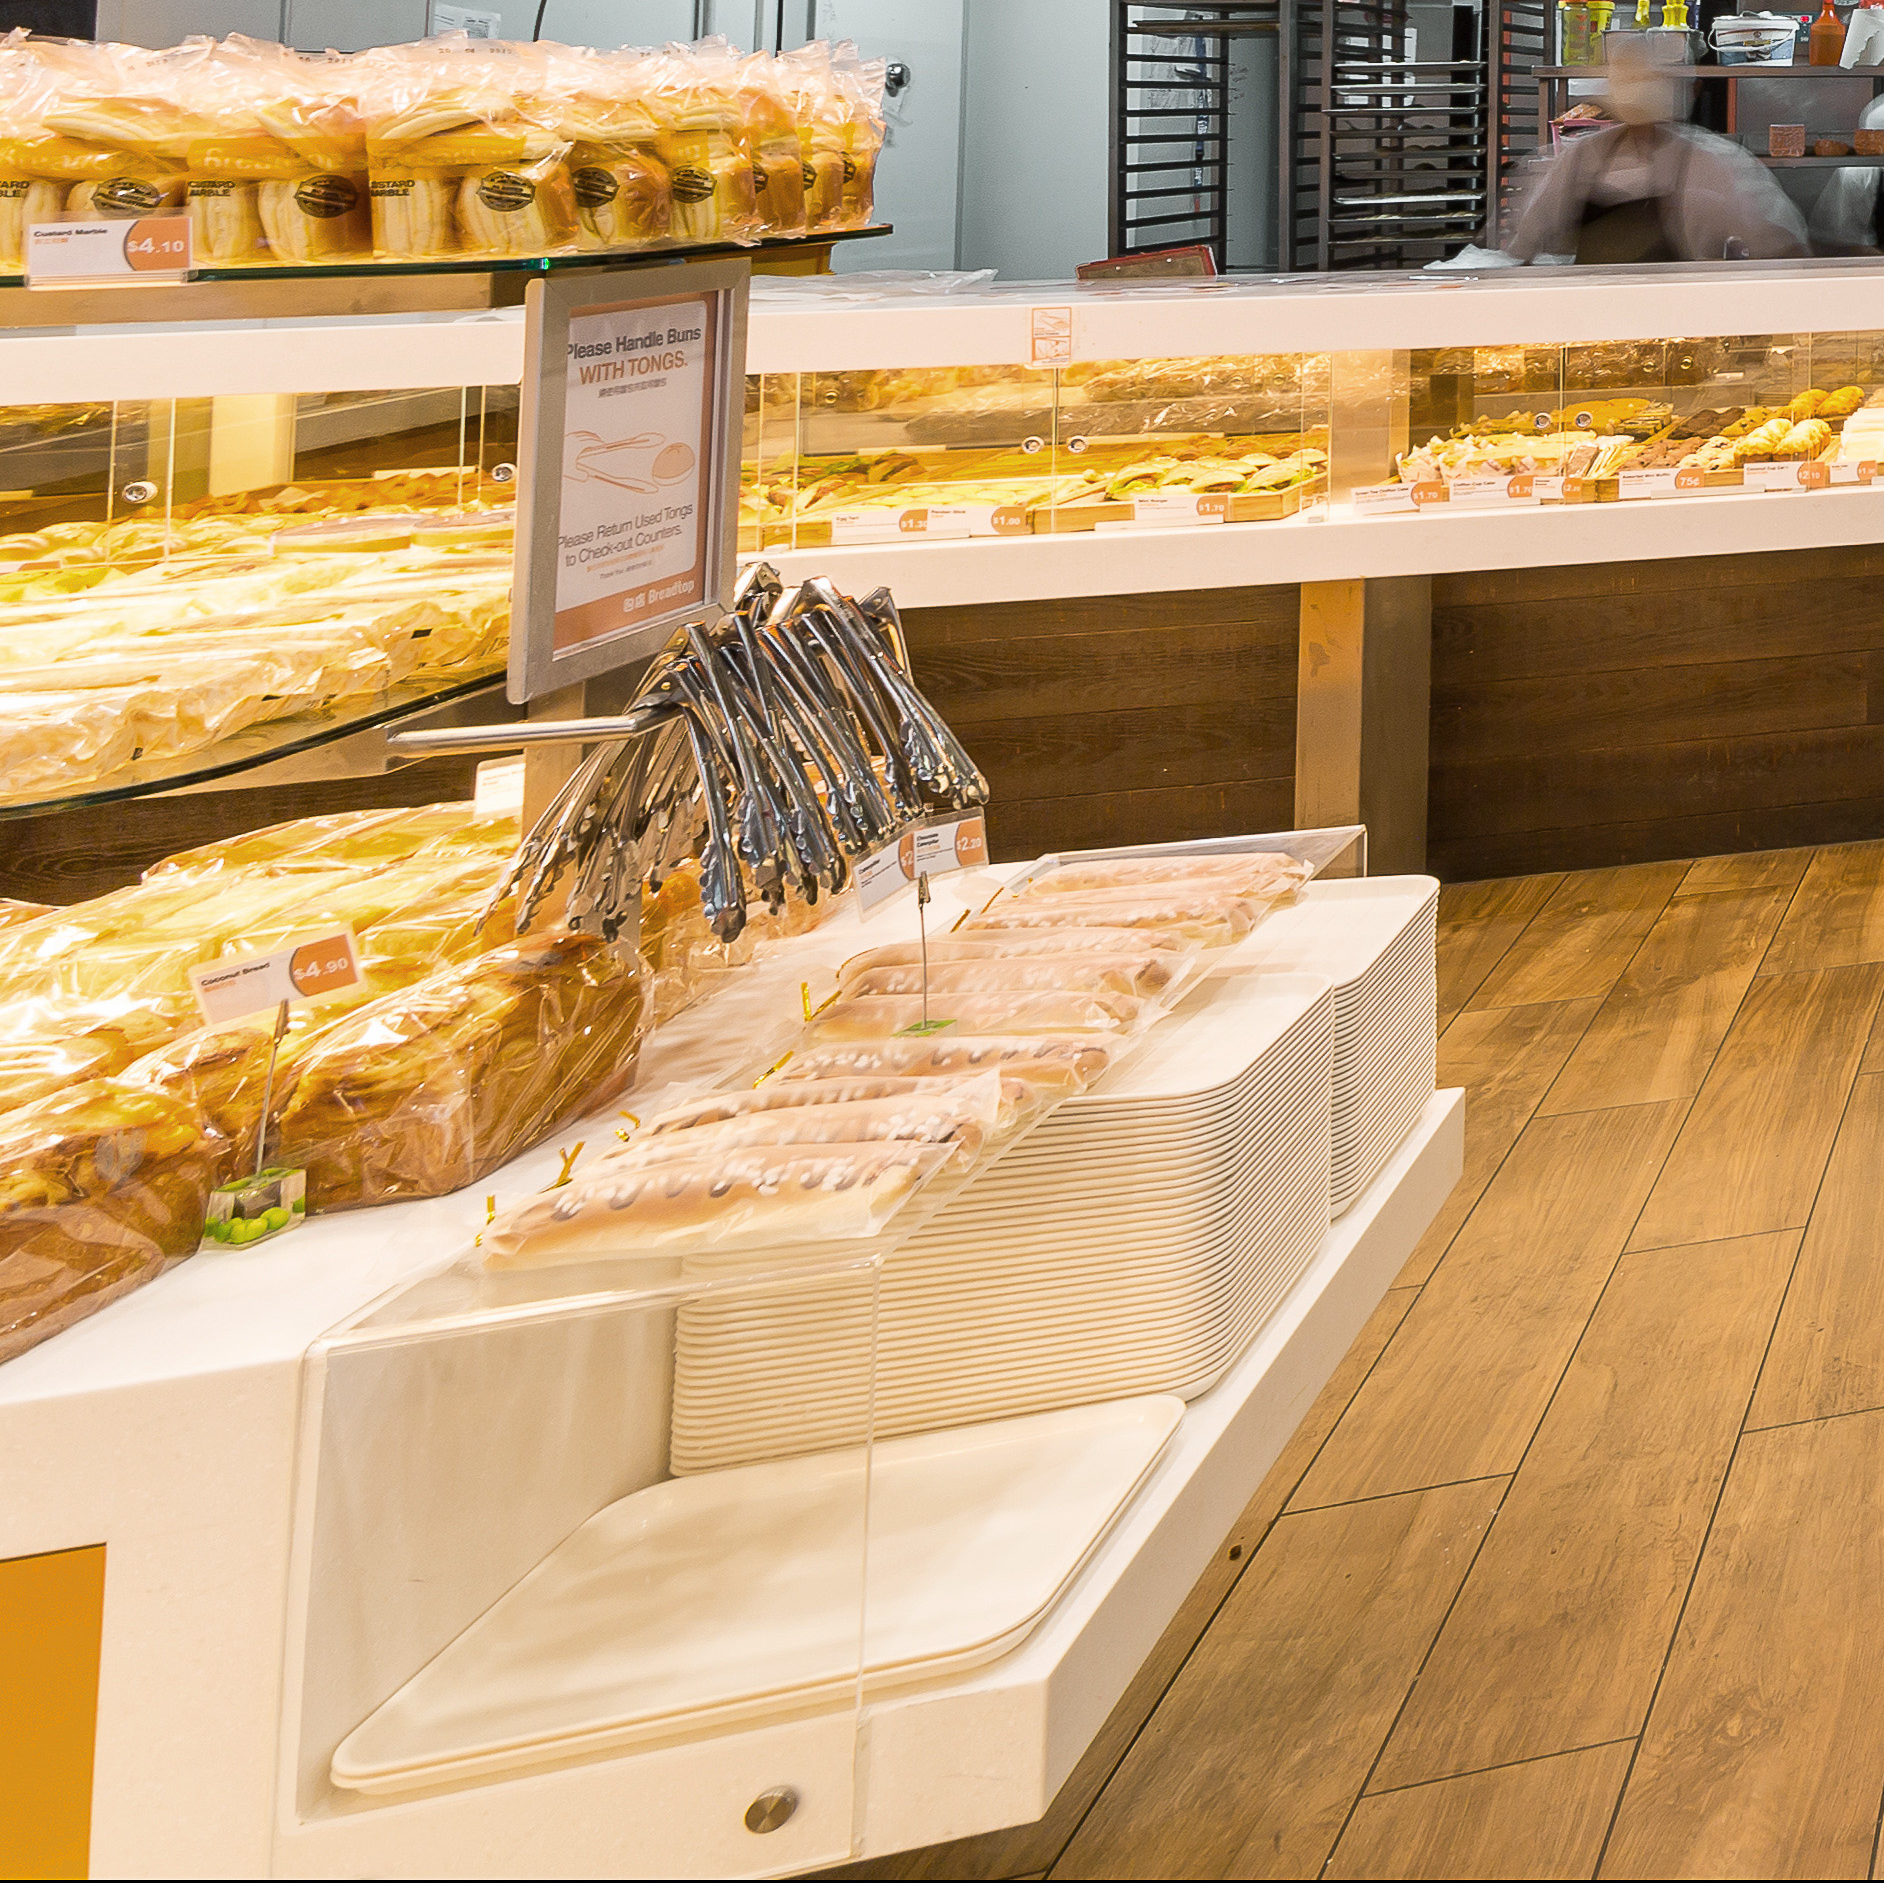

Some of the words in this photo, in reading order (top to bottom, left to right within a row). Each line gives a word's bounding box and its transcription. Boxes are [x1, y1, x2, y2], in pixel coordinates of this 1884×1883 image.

[33, 229, 73, 238] Custard
[127, 237, 185, 254] $4.10
[567, 343, 612, 359] Please
[616, 331, 664, 353] Handle
[667, 327, 702, 345] Buns
[579, 360, 625, 385] WITH
[628, 350, 689, 376] TONGS.
[1679, 476, 1700, 487] 75¢
[558, 531, 594, 549] Please
[597, 520, 633, 540] Return
[635, 510, 662, 529] Used
[664, 503, 694, 520] Tongs
[565, 554, 577, 567] to
[578, 537, 633, 563] Check-out
[635, 523, 683, 547] Counters.
[647, 579, 695, 605] Breadtop
[956, 836, 982, 852] $2.20
[200, 970, 241, 987] Coconut
[293, 956, 349, 980] $4.90
